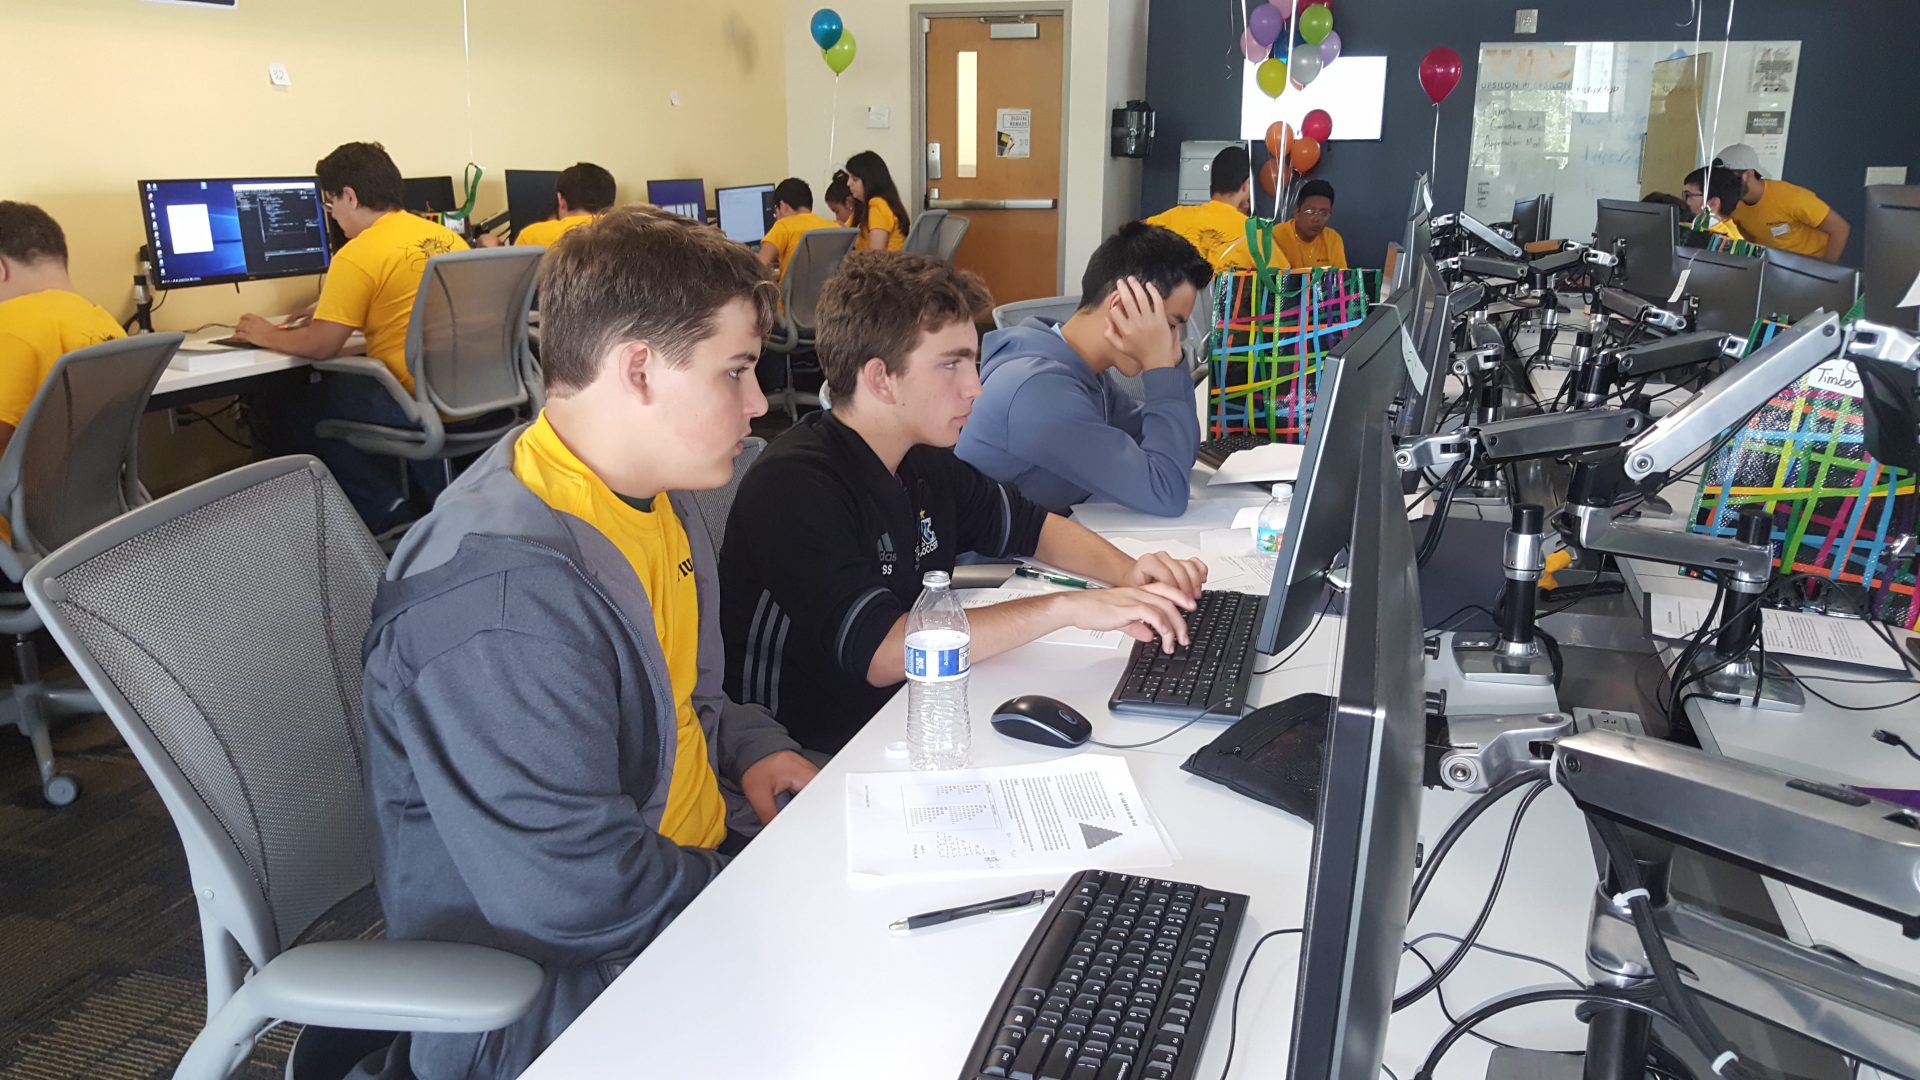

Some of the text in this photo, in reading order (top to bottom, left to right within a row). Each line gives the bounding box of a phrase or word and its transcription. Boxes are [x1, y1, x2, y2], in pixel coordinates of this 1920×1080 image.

[1481, 81, 1519, 89] UPSILON
[1817, 367, 1860, 389] Timber
[879, 551, 897, 561] das
[882, 564, 893, 575] SS
